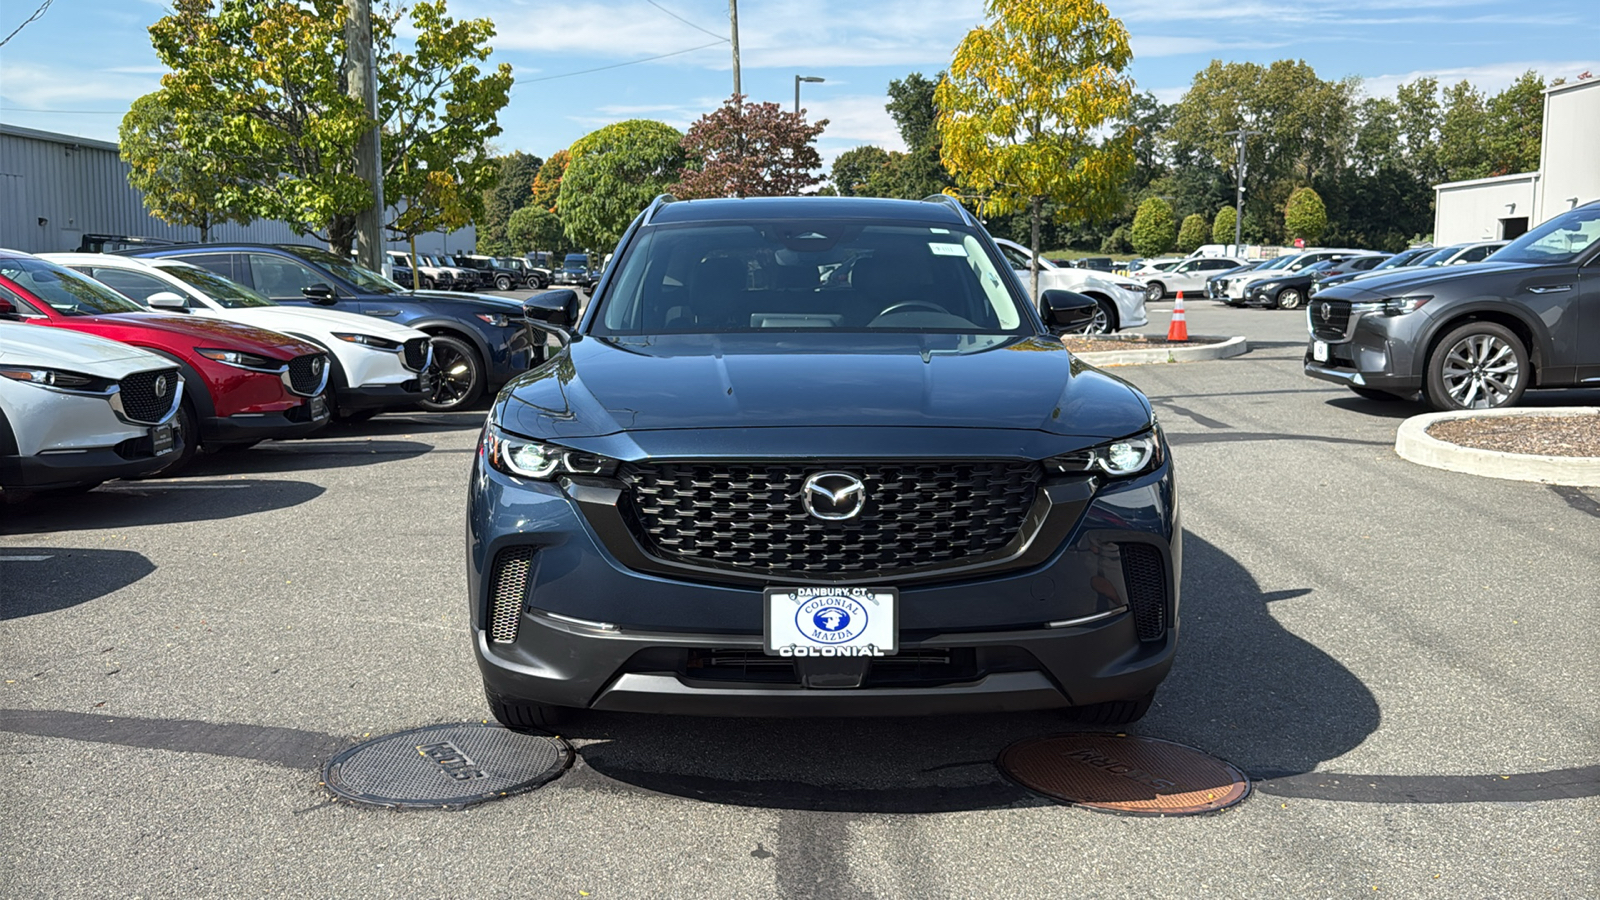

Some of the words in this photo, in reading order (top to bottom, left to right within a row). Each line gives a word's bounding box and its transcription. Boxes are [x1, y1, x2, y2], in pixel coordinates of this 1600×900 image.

[798, 588, 850, 597] DANBURY,
[852, 588, 867, 597] CT
[804, 598, 859, 616] COLONIAL
[811, 629, 853, 641] MAZDA
[779, 646, 885, 657] COLONIAL
[1065, 748, 1176, 790] STORM
